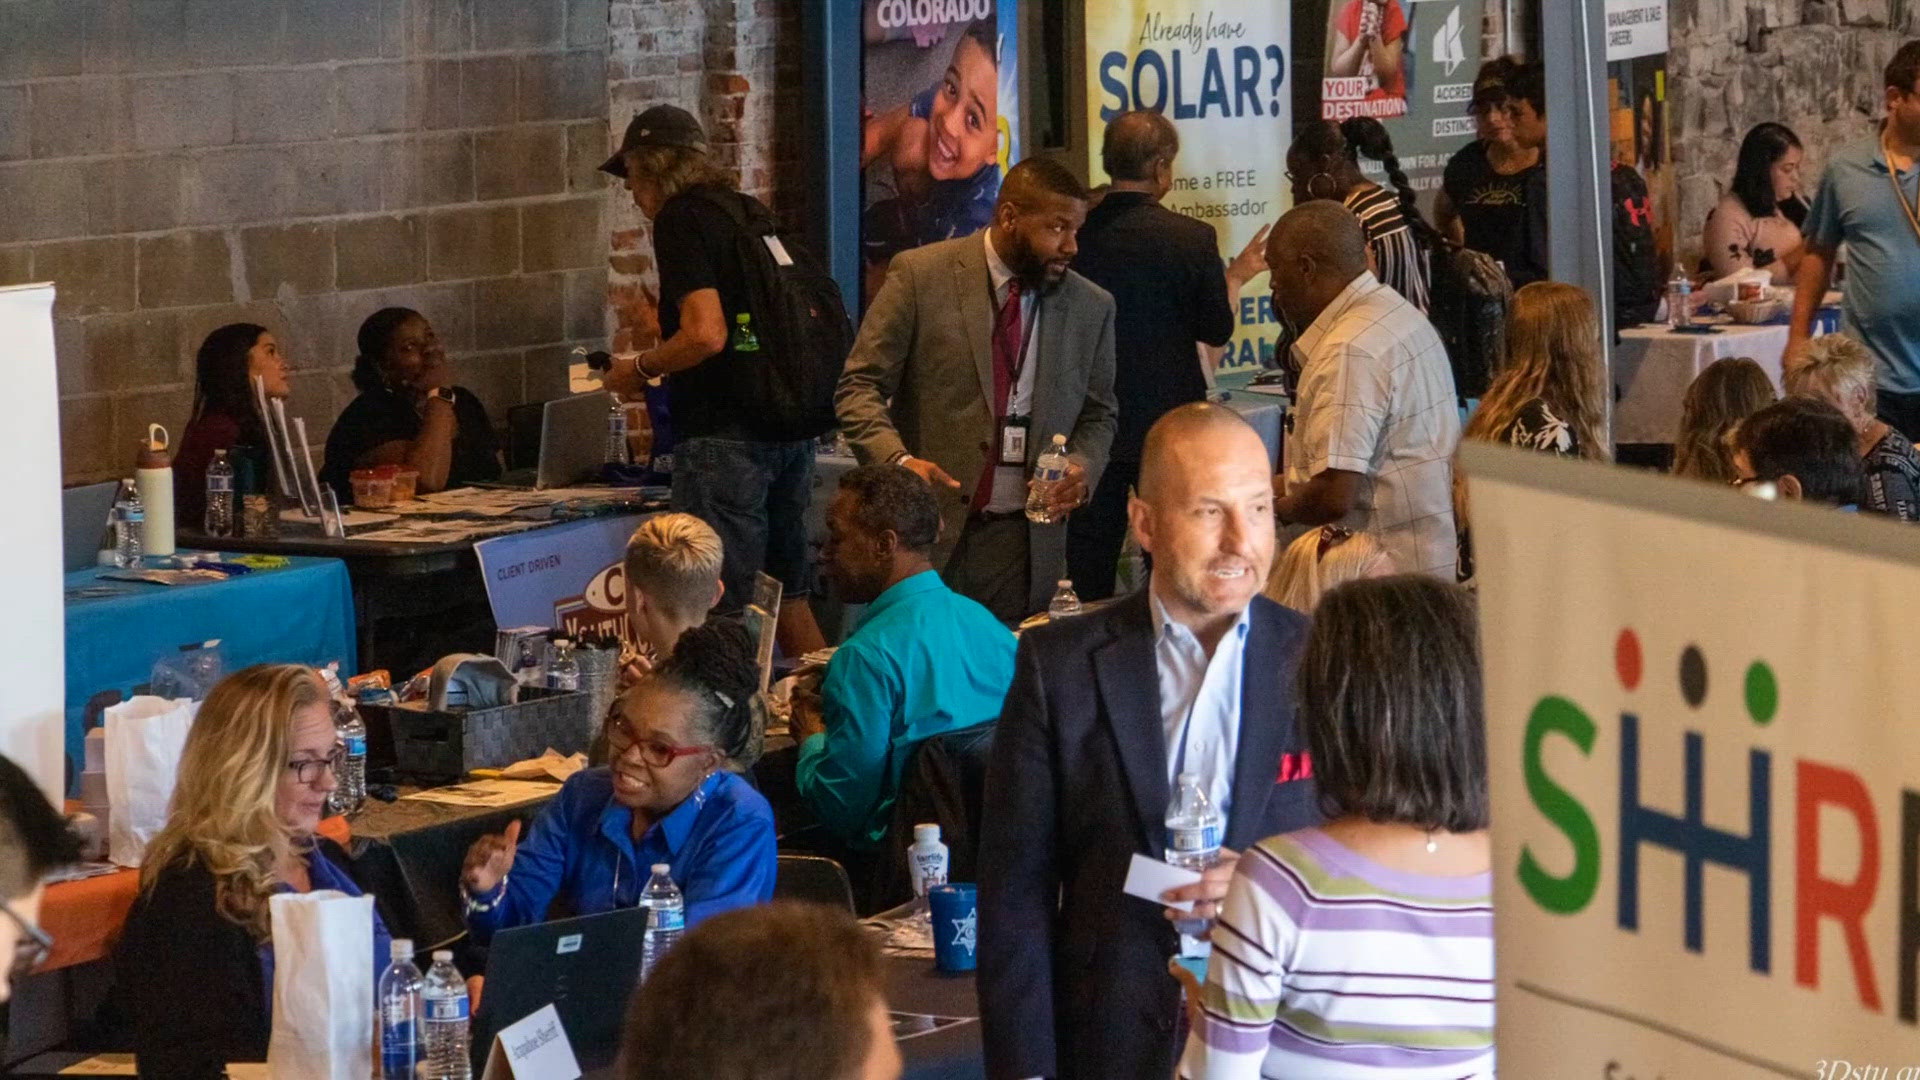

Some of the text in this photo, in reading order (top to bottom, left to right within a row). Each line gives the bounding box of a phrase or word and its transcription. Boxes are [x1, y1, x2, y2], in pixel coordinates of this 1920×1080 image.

[877, 0, 990, 28] COLORADO
[1139, 11, 1246, 54] Already have
[1099, 44, 1285, 125] SOLAR?
[1325, 80, 1364, 97] YOUR
[1203, 176, 1212, 189] a
[1216, 169, 1257, 188] FREE
[497, 554, 561, 581] CLIENT DRIVEN
